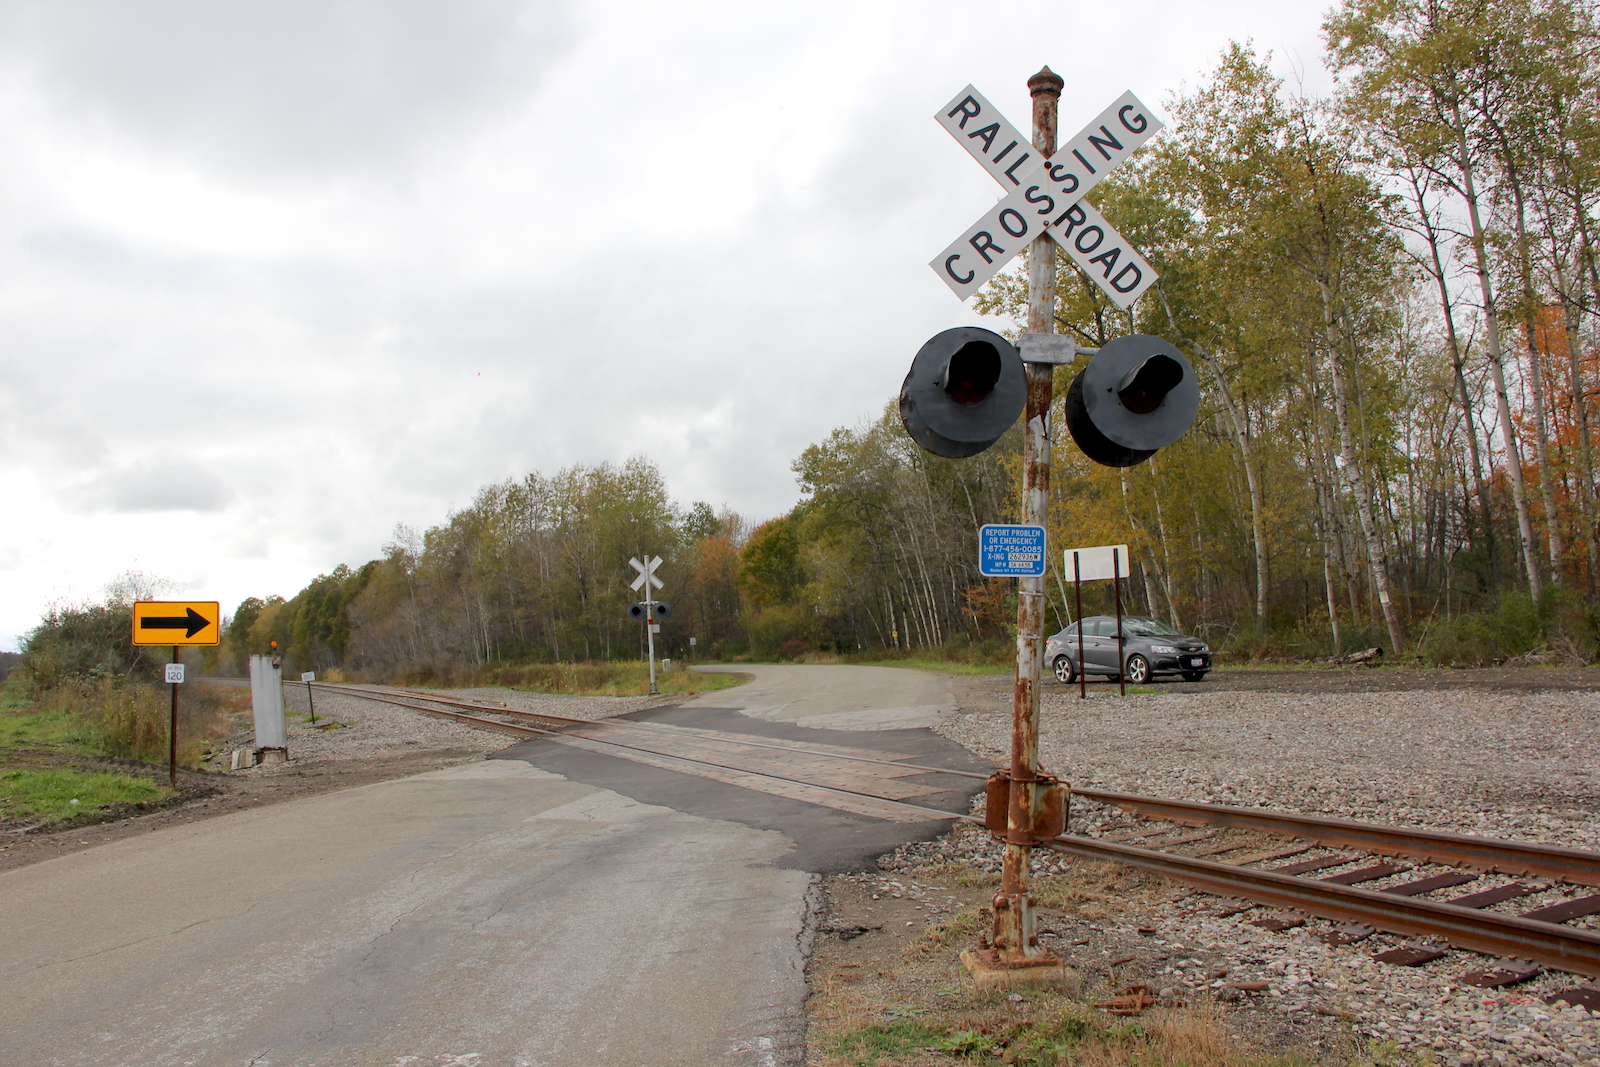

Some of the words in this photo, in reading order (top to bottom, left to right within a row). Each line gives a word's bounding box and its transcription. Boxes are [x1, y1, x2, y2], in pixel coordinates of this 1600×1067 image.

[945, 104, 1148, 285] CROSSING
[947, 94, 1030, 186] RAIL
[1053, 203, 1142, 293] ROAD
[168, 672, 182, 680] 120
